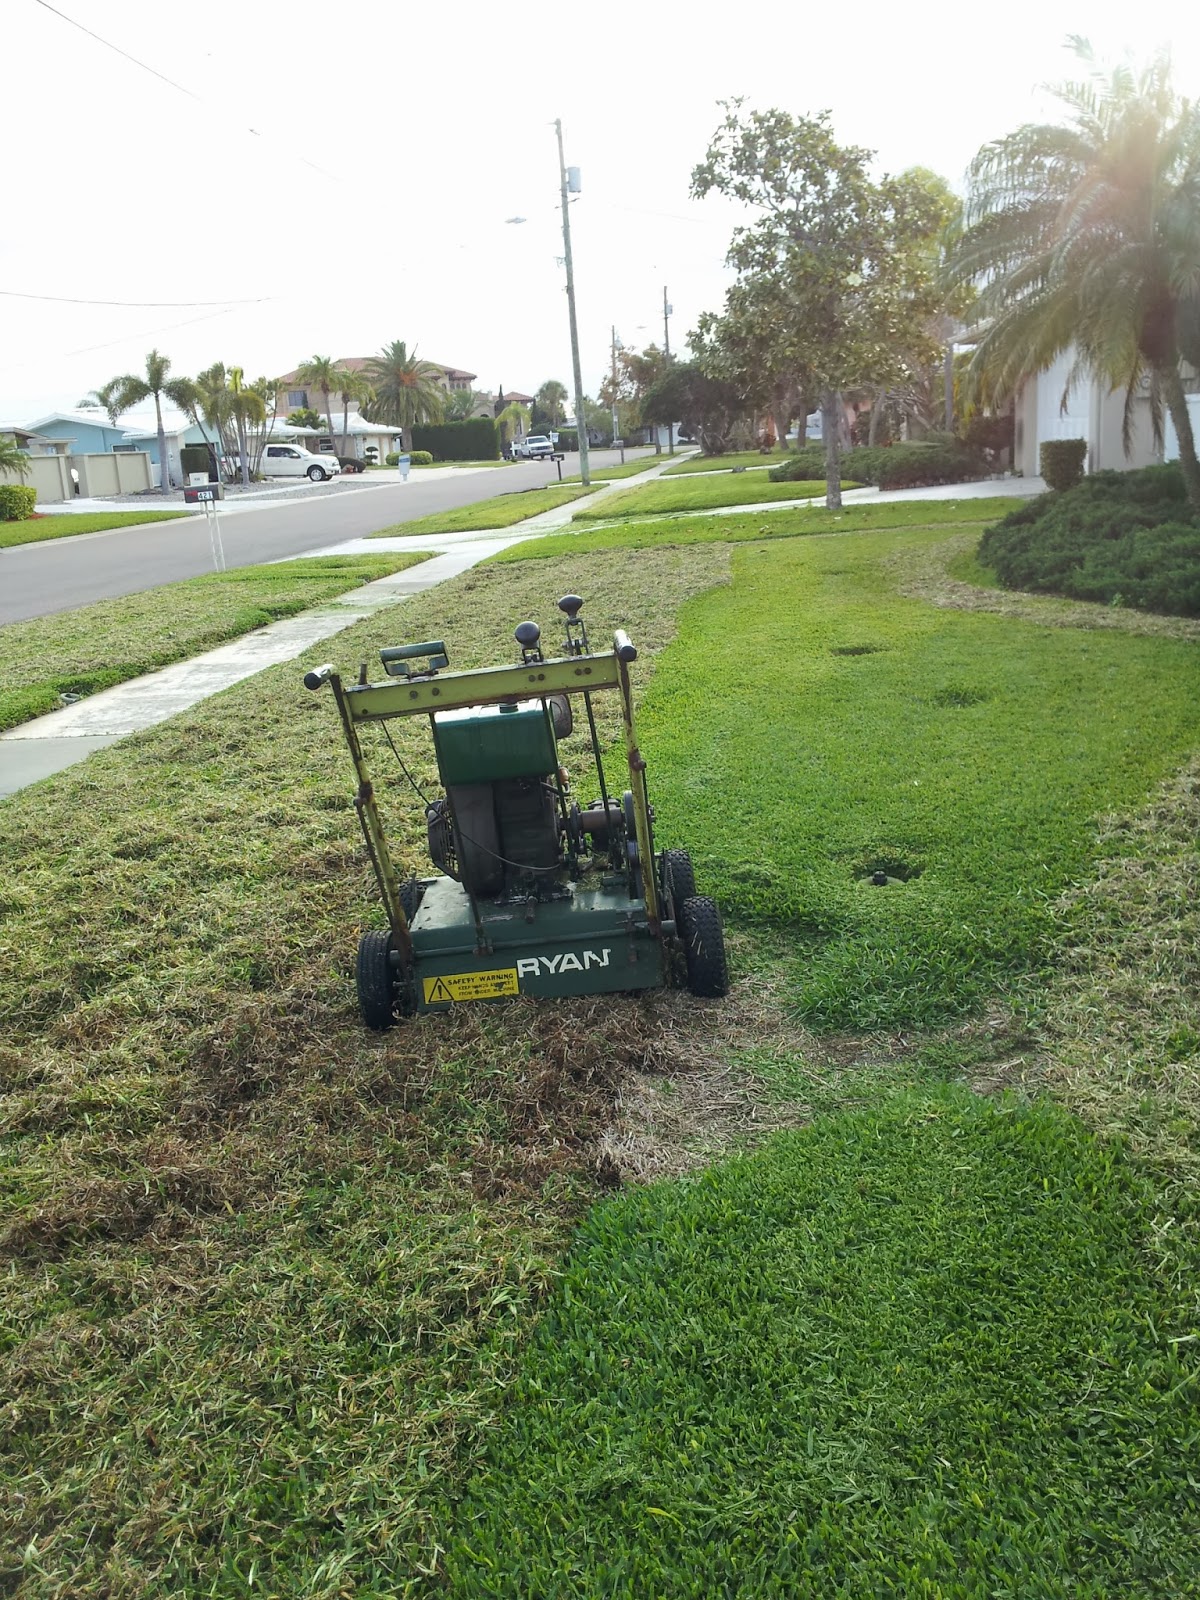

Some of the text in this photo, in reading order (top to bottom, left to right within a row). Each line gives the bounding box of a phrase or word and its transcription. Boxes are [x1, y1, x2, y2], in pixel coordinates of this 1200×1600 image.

[516, 948, 611, 978] RYAN
[448, 973, 514, 985] SAFETY WARNING
